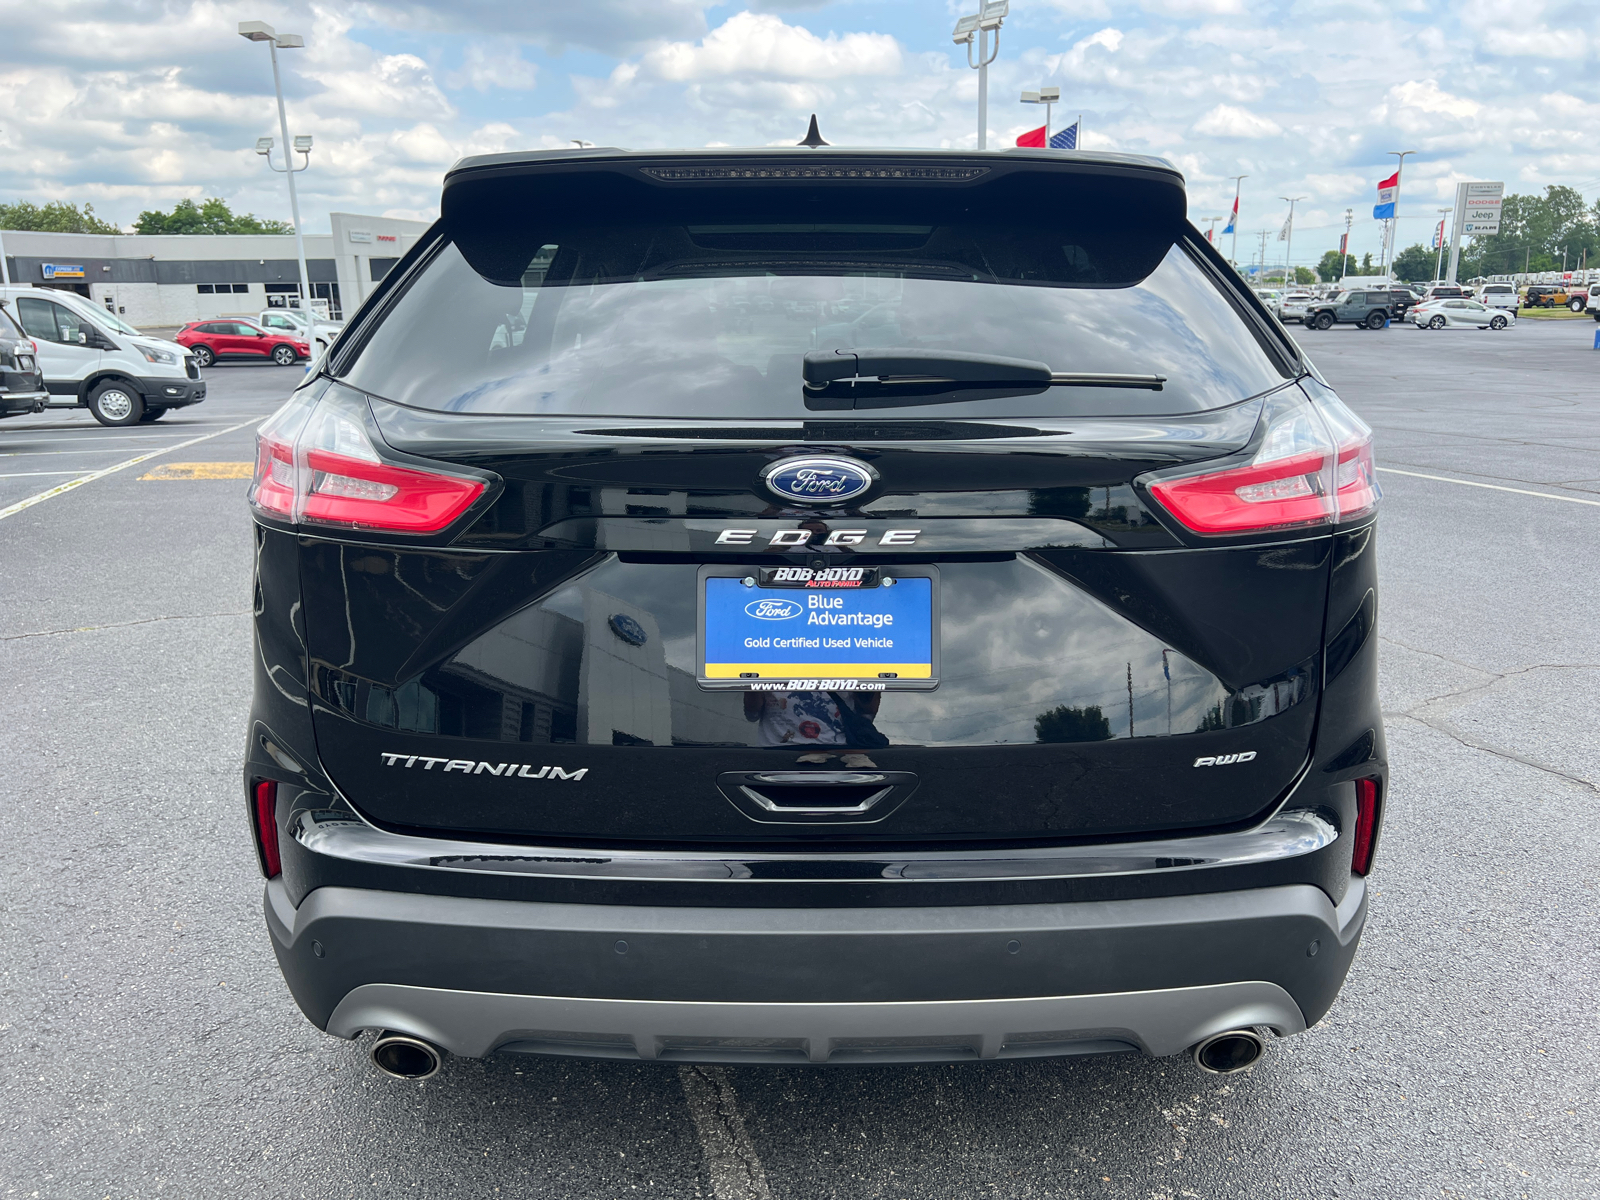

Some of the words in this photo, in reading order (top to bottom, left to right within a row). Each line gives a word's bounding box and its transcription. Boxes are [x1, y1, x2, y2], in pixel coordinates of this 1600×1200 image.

[1472, 210, 1494, 220] Jeep
[790, 468, 848, 493] Ford
[714, 528, 922, 546] EDGE
[755, 601, 792, 617] Ford
[807, 595, 843, 609] Blue
[807, 611, 893, 628] Advantage
[744, 637, 770, 648] Gold
[773, 637, 820, 648] Certified
[822, 637, 851, 648] Used
[854, 637, 893, 648] Vehicle
[381, 752, 589, 781] TITANIUM
[1193, 751, 1257, 767] AWD
